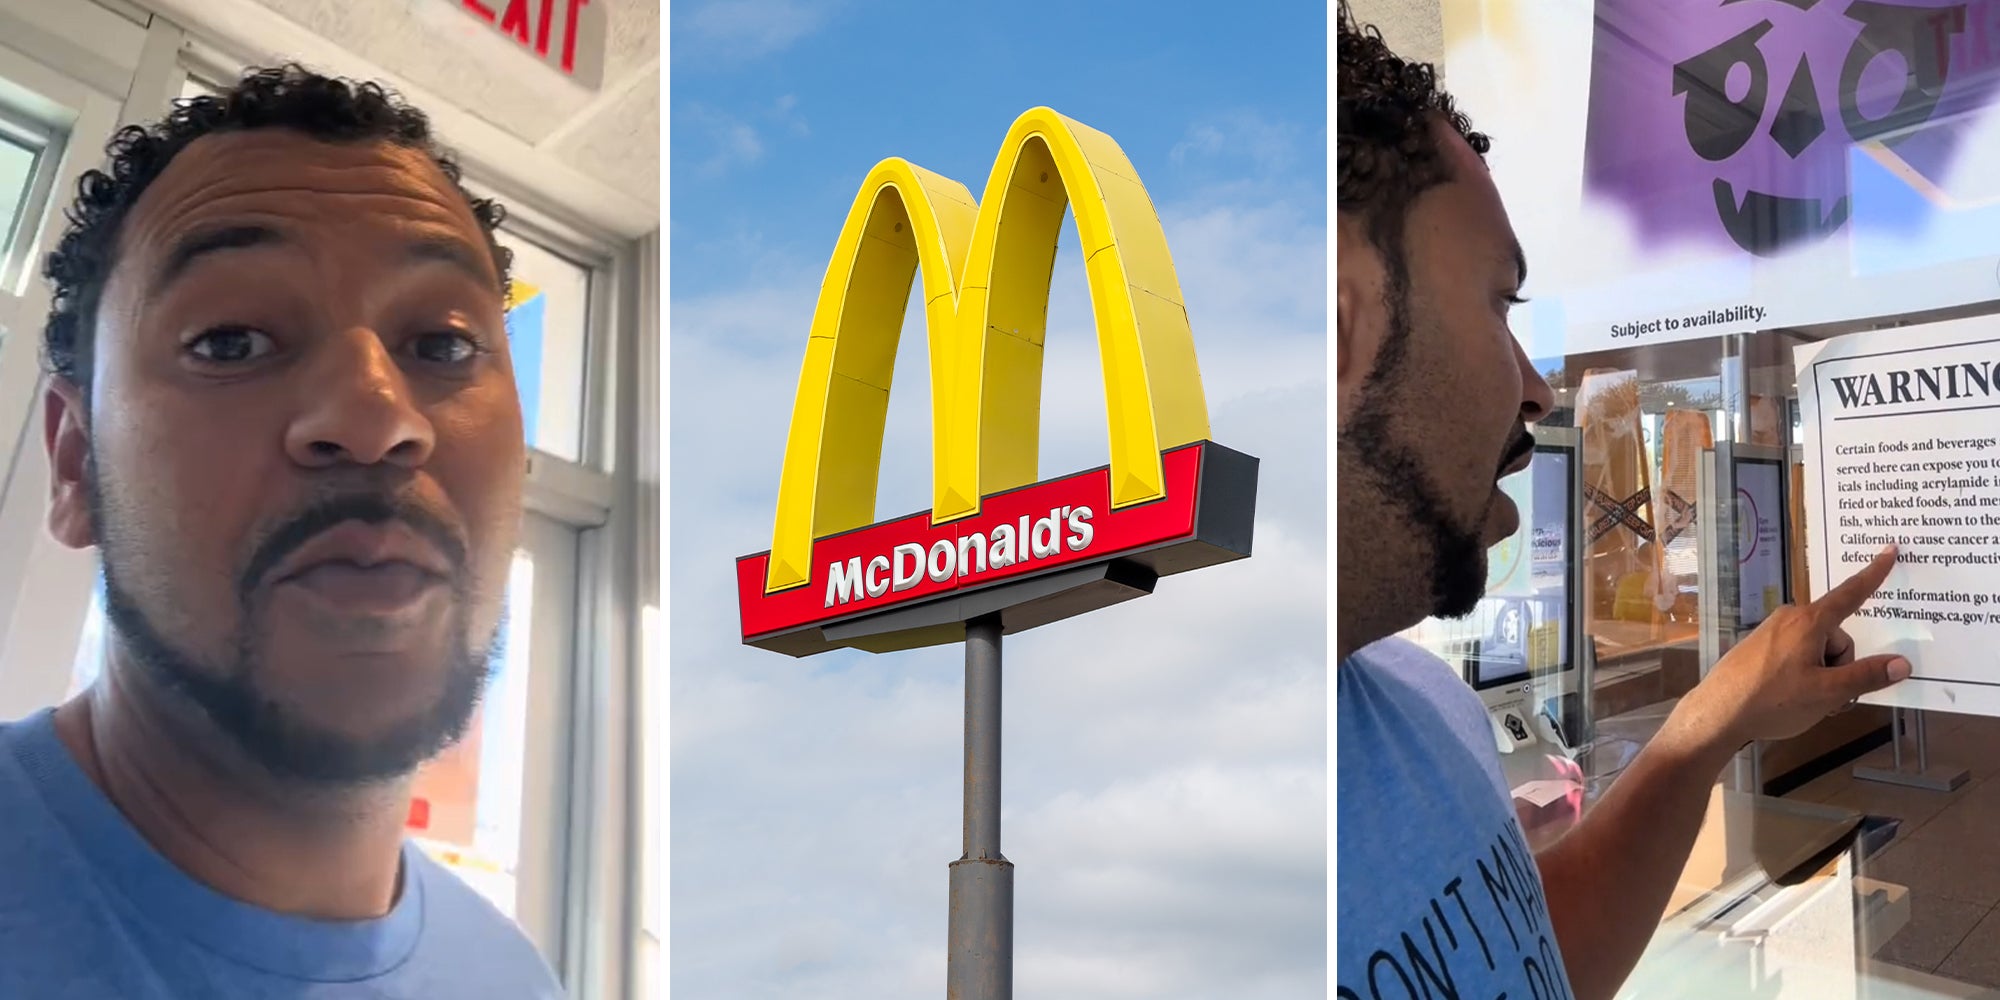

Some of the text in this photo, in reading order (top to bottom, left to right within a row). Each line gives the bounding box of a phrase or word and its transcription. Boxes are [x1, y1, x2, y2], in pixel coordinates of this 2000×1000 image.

[461, 0, 590, 75] XIT
[1611, 305, 1767, 339] Subject to availability.
[1835, 437, 1996, 455] Certain foods and beverages
[1836, 462, 1870, 475] served
[1873, 461, 1898, 473] here
[1900, 462, 1920, 472] can
[1923, 460, 1963, 474] expose
[1965, 459, 1988, 472] you
[1838, 480, 1862, 492] icals
[1865, 478, 1919, 493] including
[1922, 476, 1990, 492] acrylamide
[1838, 495, 2000, 510] fried or baked foods, and me
[1840, 513, 2000, 528] fish, which are known to the
[1840, 533, 1896, 545] California
[1898, 535, 1910, 545] to
[1913, 535, 1945, 545] cause
[1948, 535, 1989, 545] cancer
[824, 505, 1094, 609] McDonald's
[1841, 551, 2000, 567] defect other reproducti
[1897, 588, 1970, 602] information
[1973, 594, 1989, 606] go
